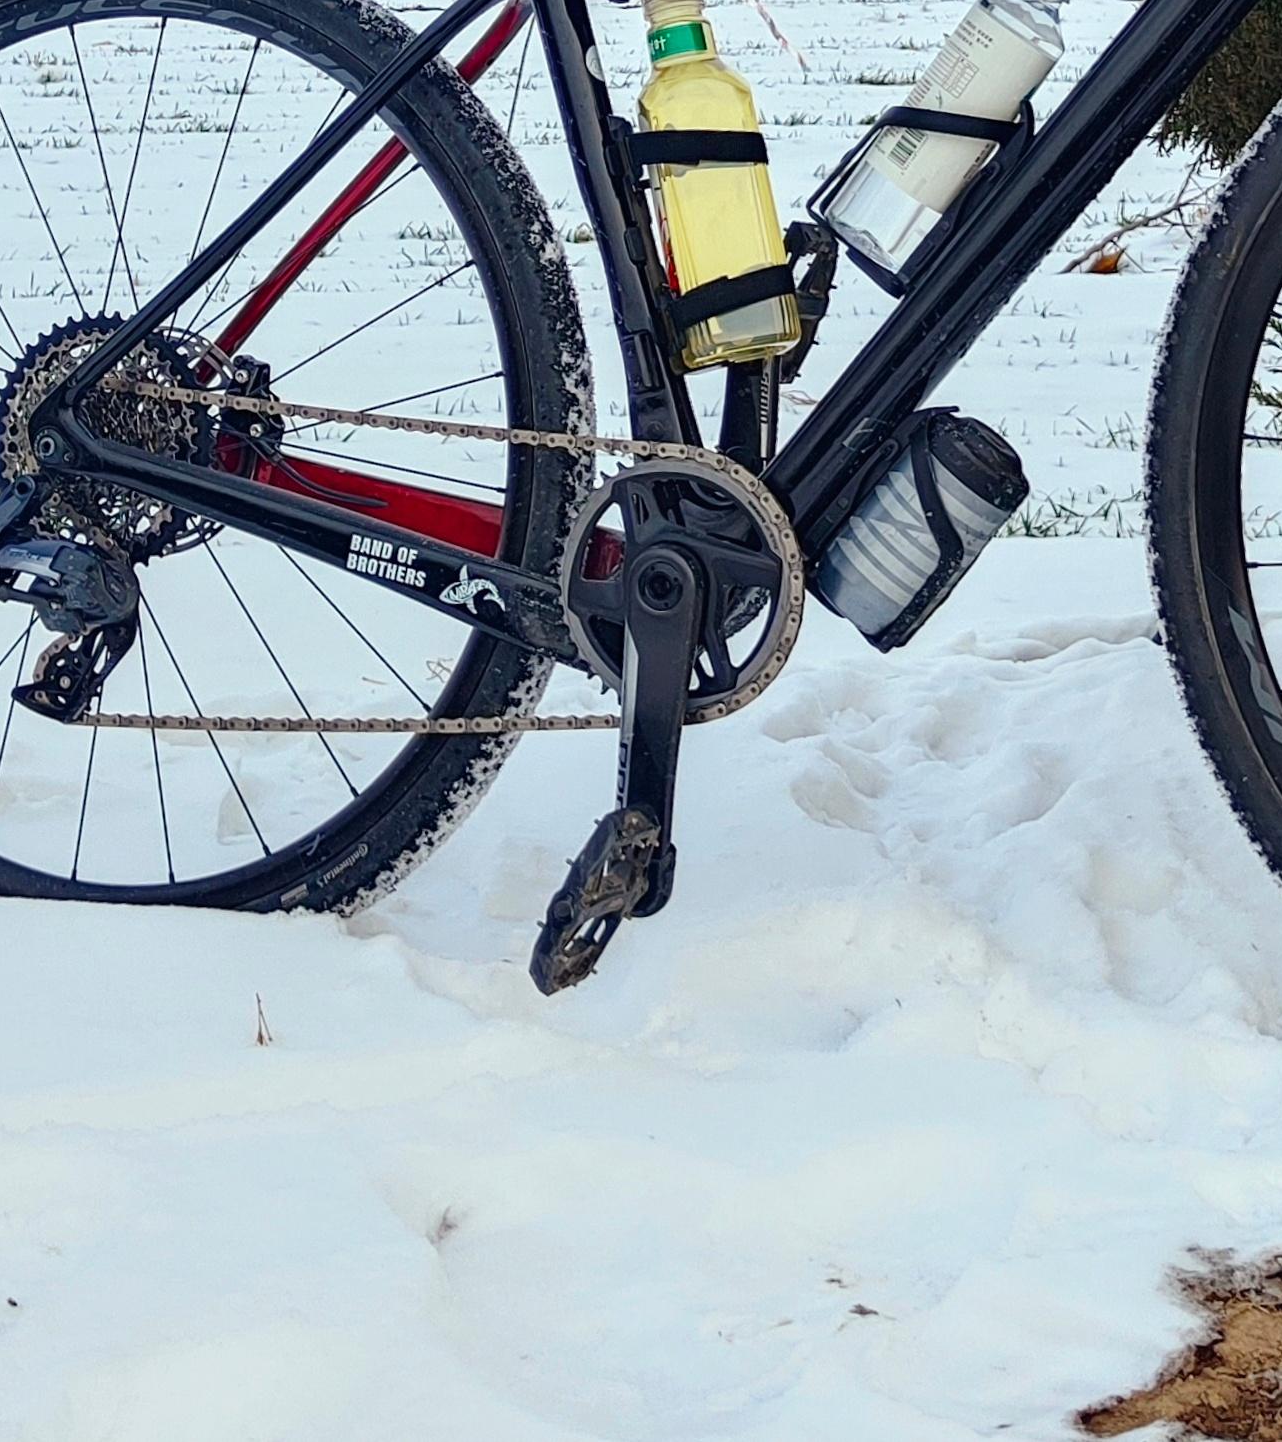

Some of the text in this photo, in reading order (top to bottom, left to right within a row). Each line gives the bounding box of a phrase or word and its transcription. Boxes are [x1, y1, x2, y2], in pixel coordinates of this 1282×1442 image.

[350, 534, 418, 566] BAND OF
[346, 552, 428, 588] BROTHERS
